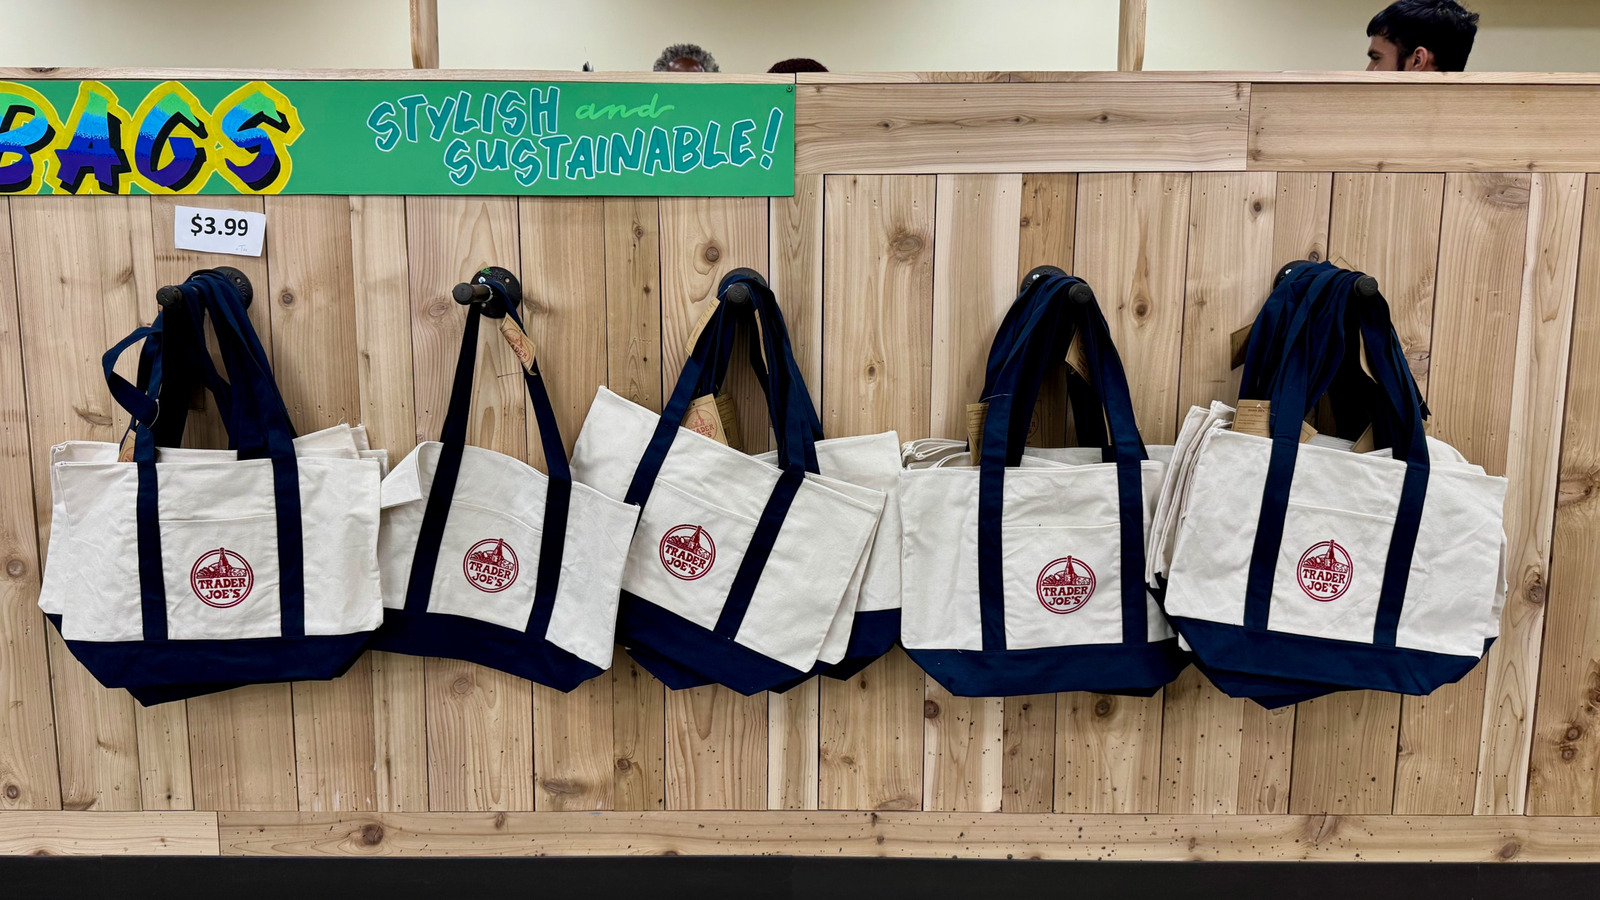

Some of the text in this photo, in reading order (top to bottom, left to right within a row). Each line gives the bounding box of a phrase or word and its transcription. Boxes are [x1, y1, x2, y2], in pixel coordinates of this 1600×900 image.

[367, 86, 675, 152] STYLISH and
[0, 81, 304, 194] BAGS
[190, 213, 249, 237] $3.99
[665, 544, 707, 569] TRADER
[469, 561, 511, 580] TRADER
[666, 557, 699, 575] JOE'S
[197, 578, 247, 589] TRADER
[472, 572, 505, 587] JOE'S
[1302, 568, 1346, 584] TRADER
[205, 589, 242, 599] JOE'S
[1042, 586, 1088, 596] TRADER
[1307, 581, 1341, 594] JOE'S
[1048, 596, 1082, 606] JOE'S
